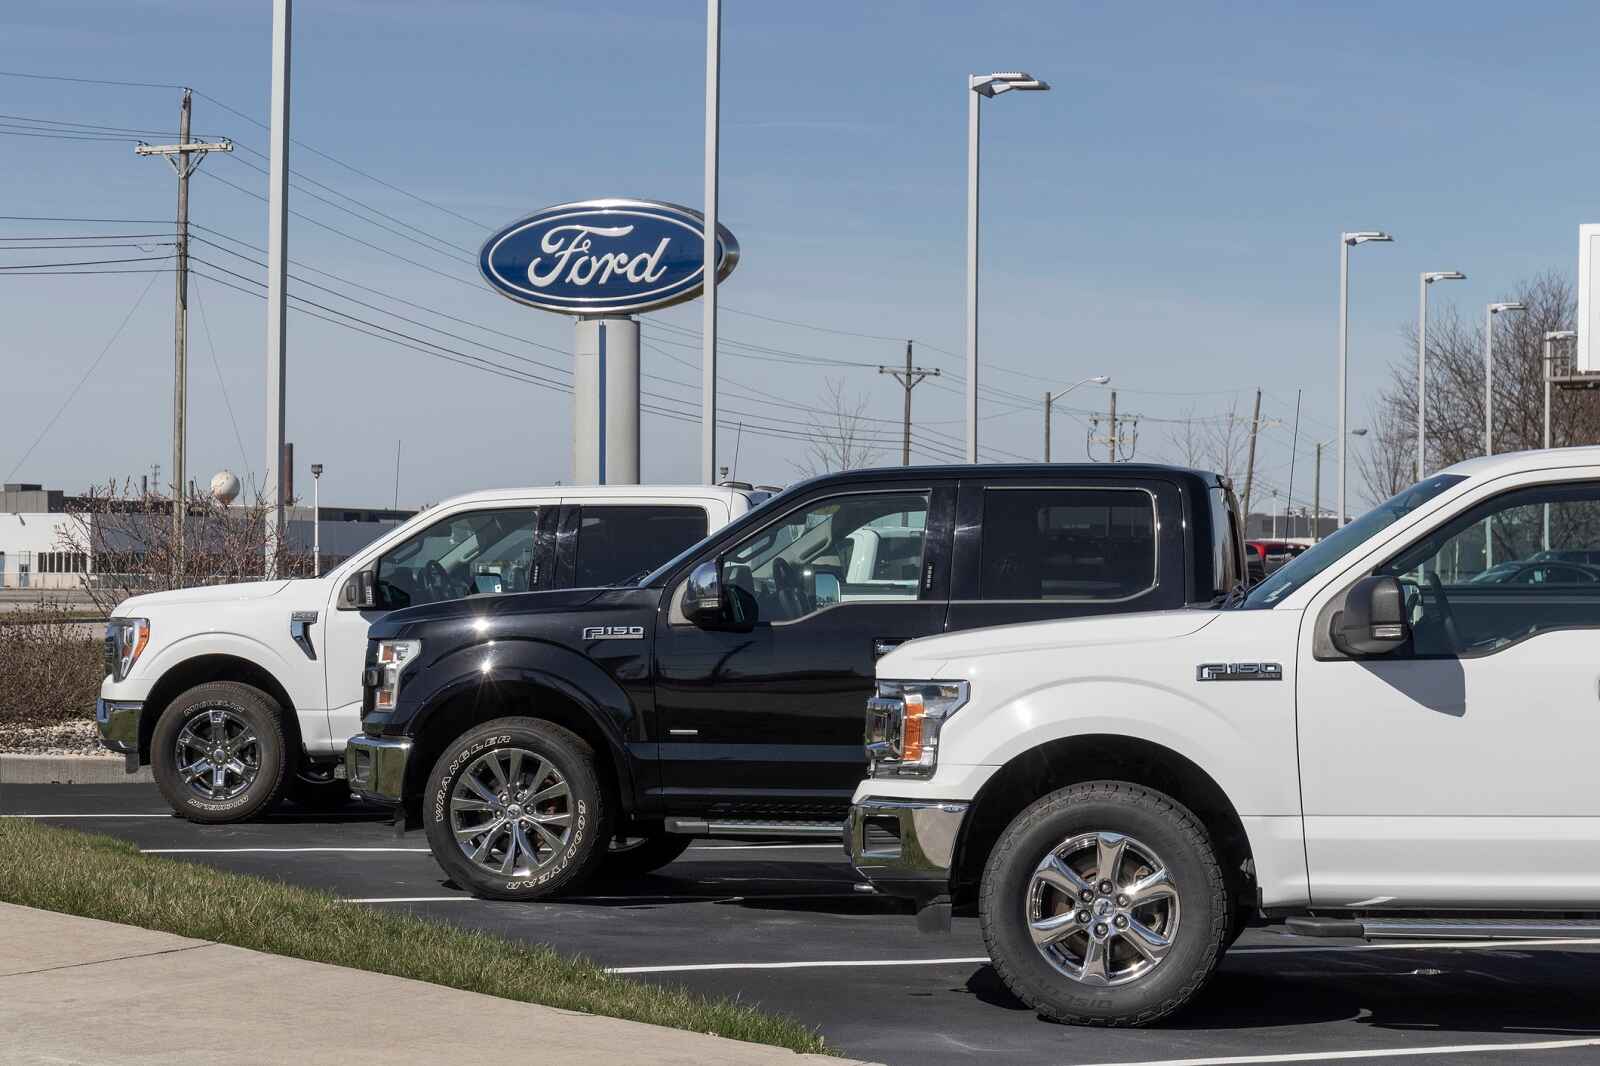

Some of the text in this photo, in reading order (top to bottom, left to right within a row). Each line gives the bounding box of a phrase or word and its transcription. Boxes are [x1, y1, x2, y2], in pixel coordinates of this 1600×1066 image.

[527, 224, 672, 288] Ford
[183, 700, 245, 717] MICHELIN
[431, 735, 511, 823] WRANGLER
[506, 799, 586, 890] GOODYEAR
